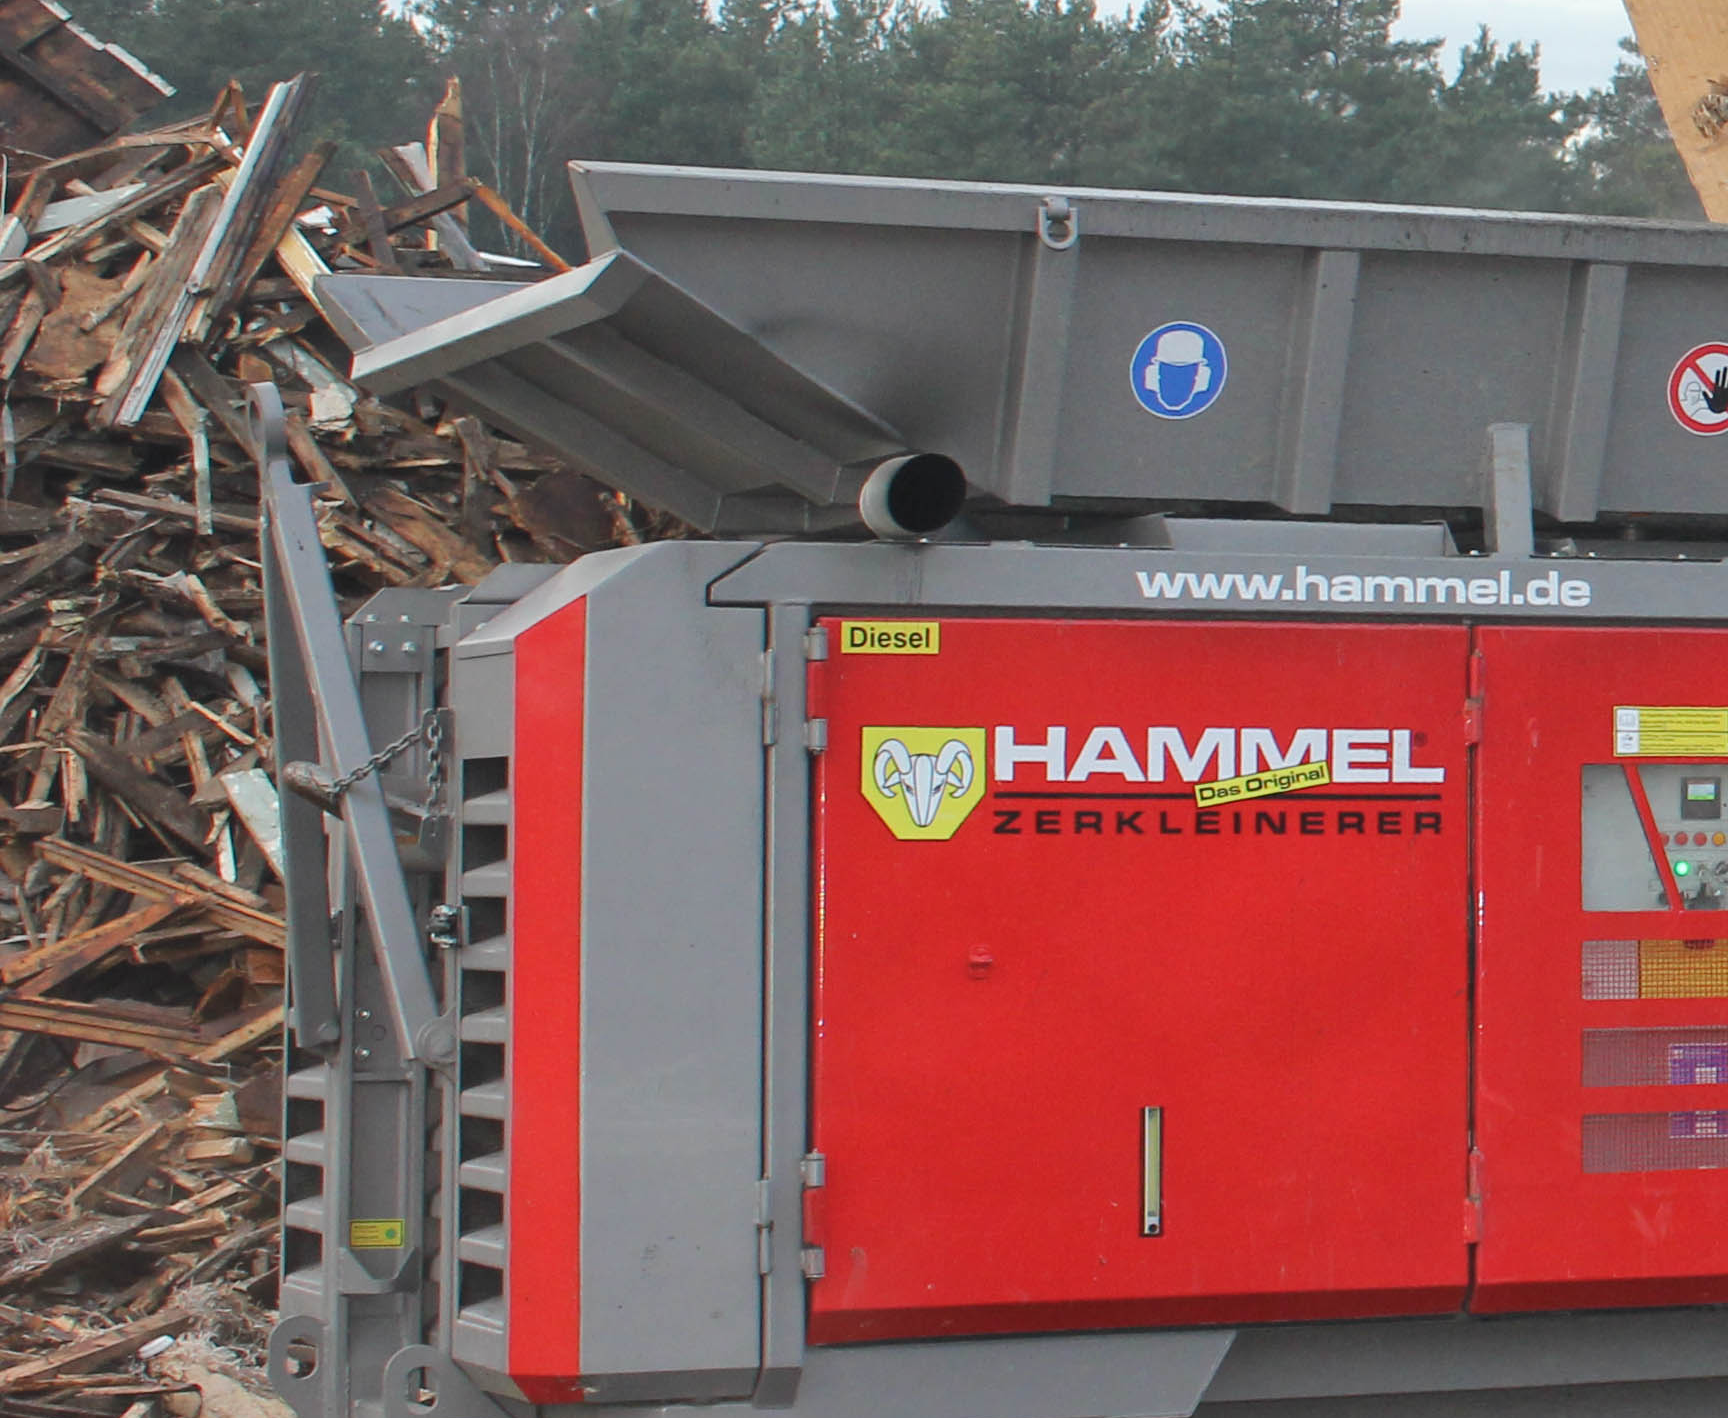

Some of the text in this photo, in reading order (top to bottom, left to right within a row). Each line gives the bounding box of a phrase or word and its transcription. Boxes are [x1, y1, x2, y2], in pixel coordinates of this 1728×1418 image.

[1135, 565, 1592, 607] www.hammel.de
[849, 626, 931, 648] Diesel
[993, 726, 1445, 783] HAMMEL
[1198, 765, 1326, 802] Das Original
[993, 810, 1442, 835] ZERKLEINERER
